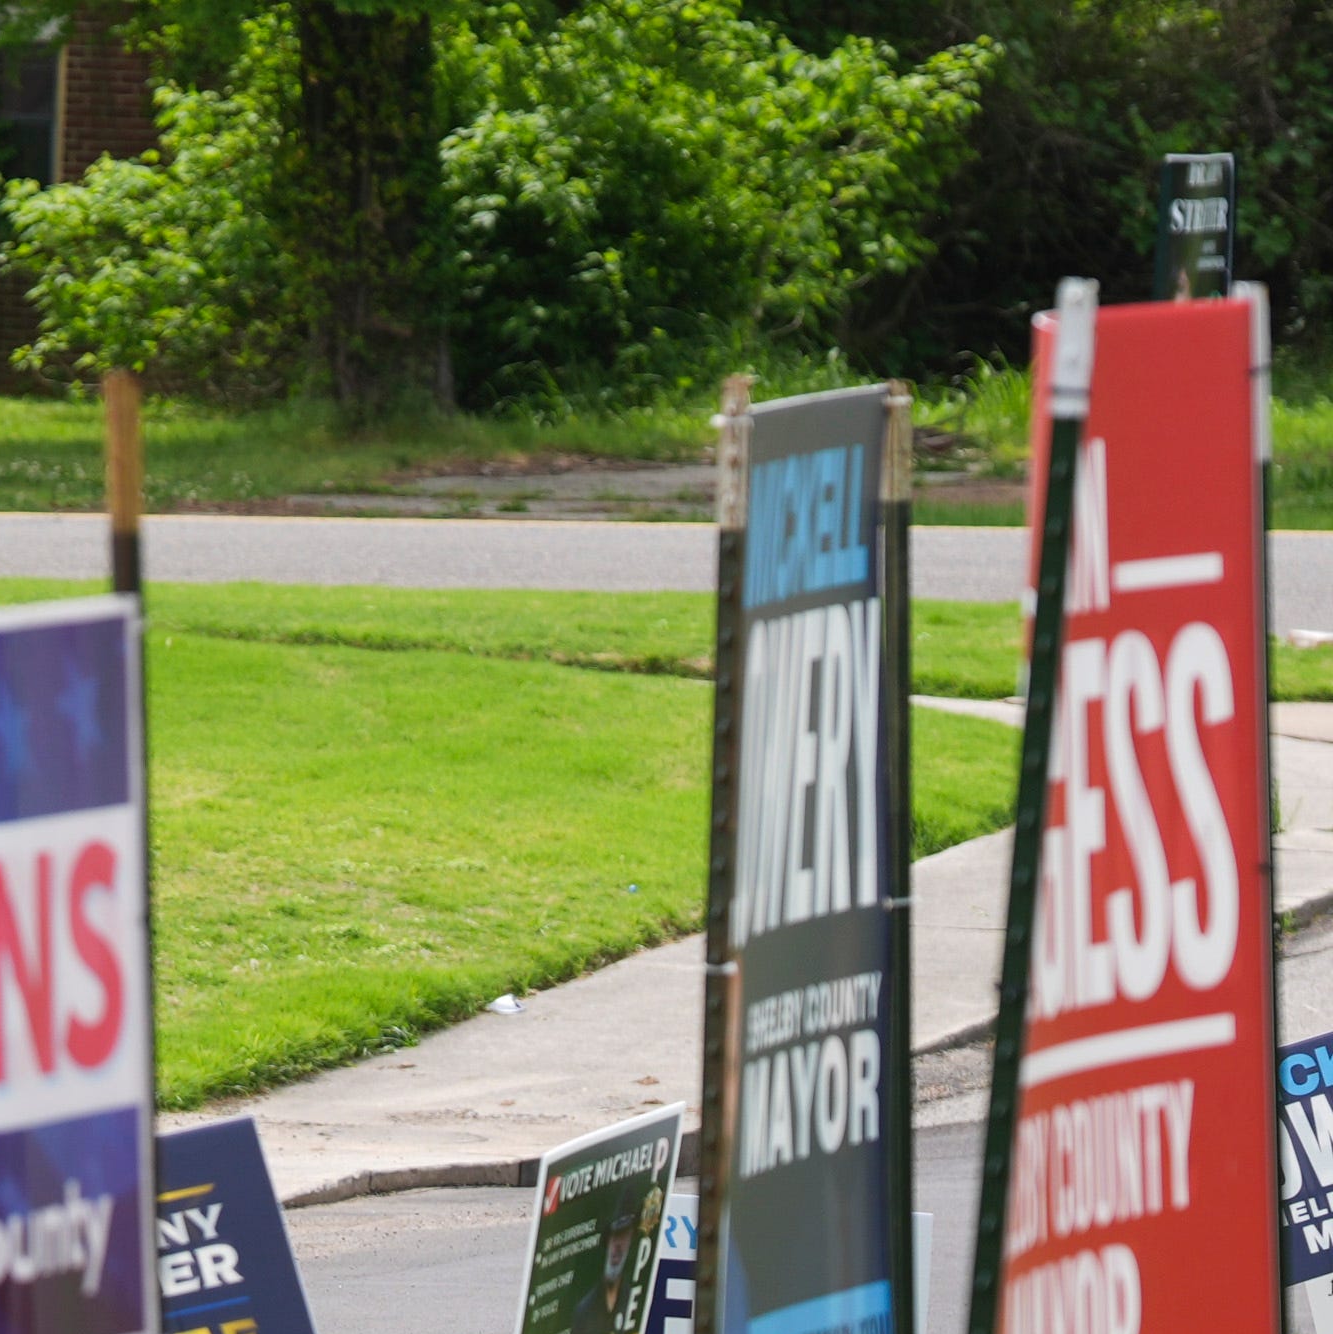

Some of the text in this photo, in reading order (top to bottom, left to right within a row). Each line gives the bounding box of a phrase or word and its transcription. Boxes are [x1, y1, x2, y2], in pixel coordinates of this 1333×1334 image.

[729, 597, 881, 947] OWERY
[804, 970, 882, 1034] COUNTY
[739, 1028, 881, 1179] MAYOR
[560, 1143, 654, 1202] VOTE MICHAEL
[1051, 1078, 1194, 1237] COUNTY
[157, 1203, 223, 1250] NY
[159, 1242, 245, 1298] ER
